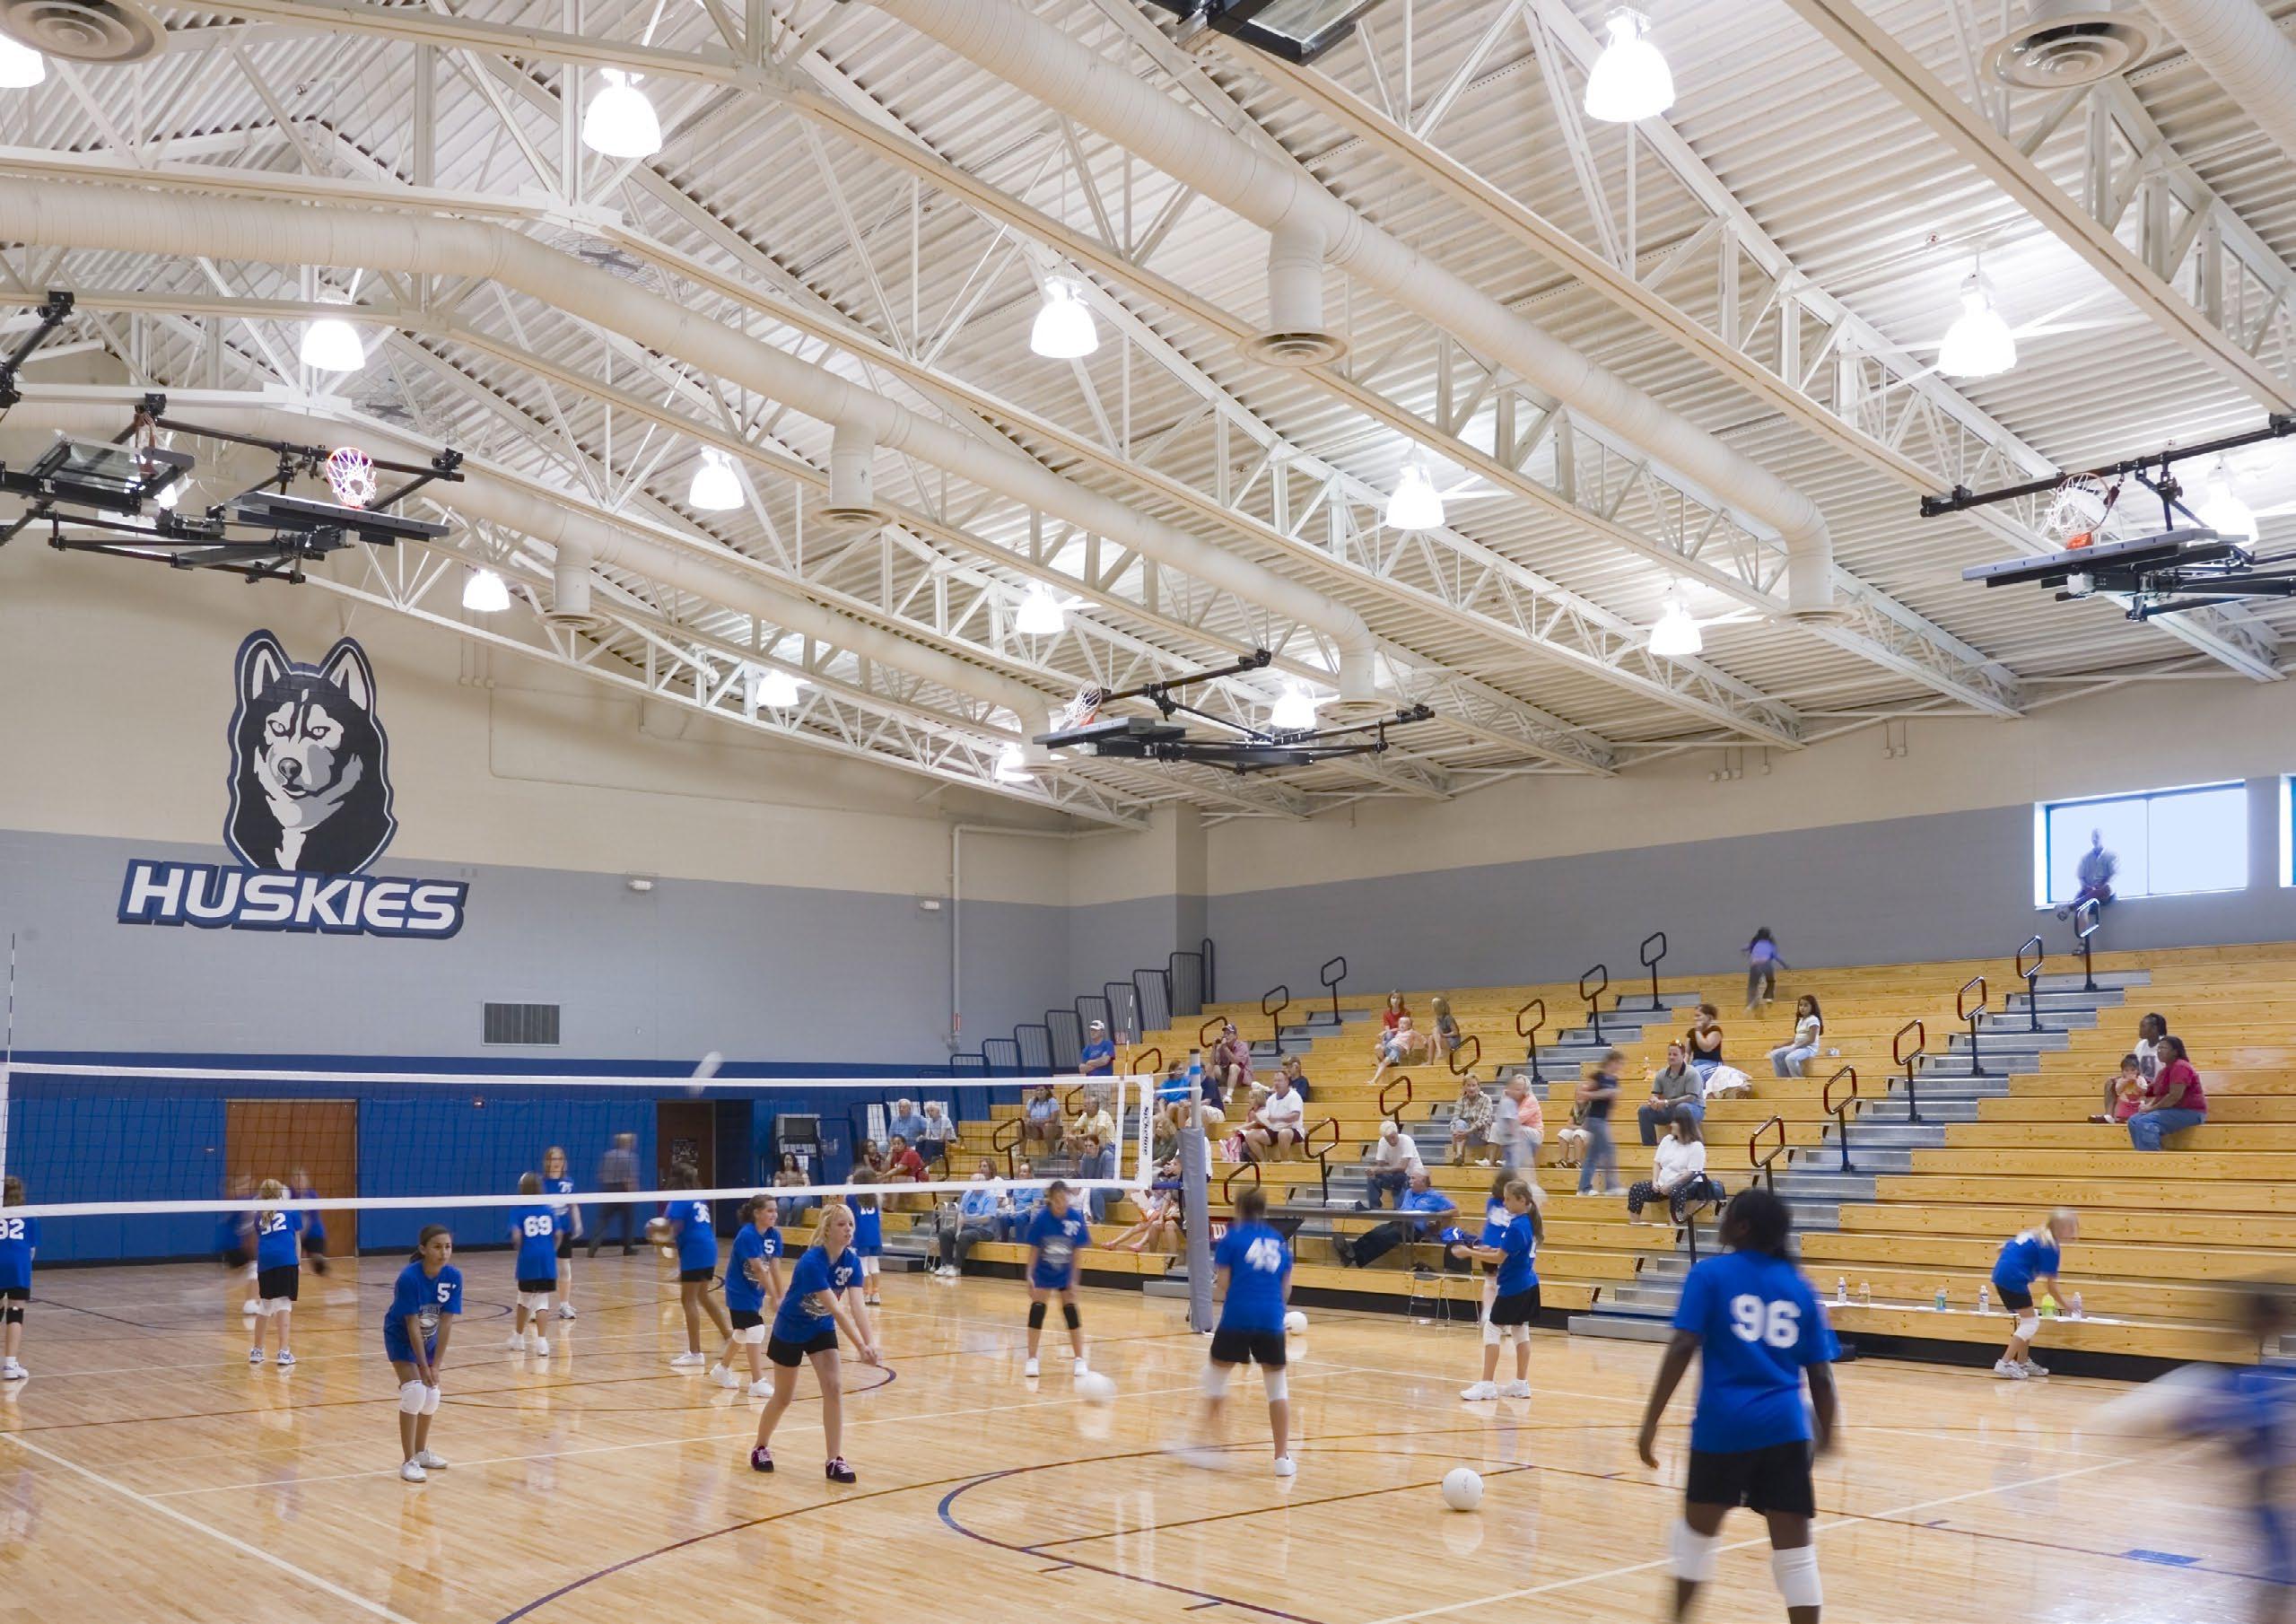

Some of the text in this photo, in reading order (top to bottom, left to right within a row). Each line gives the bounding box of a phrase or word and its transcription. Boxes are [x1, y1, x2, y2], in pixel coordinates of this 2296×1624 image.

[127, 866, 459, 930] HUSKIES
[523, 1216, 553, 1237] 69
[1730, 1294, 1802, 1349] 96
